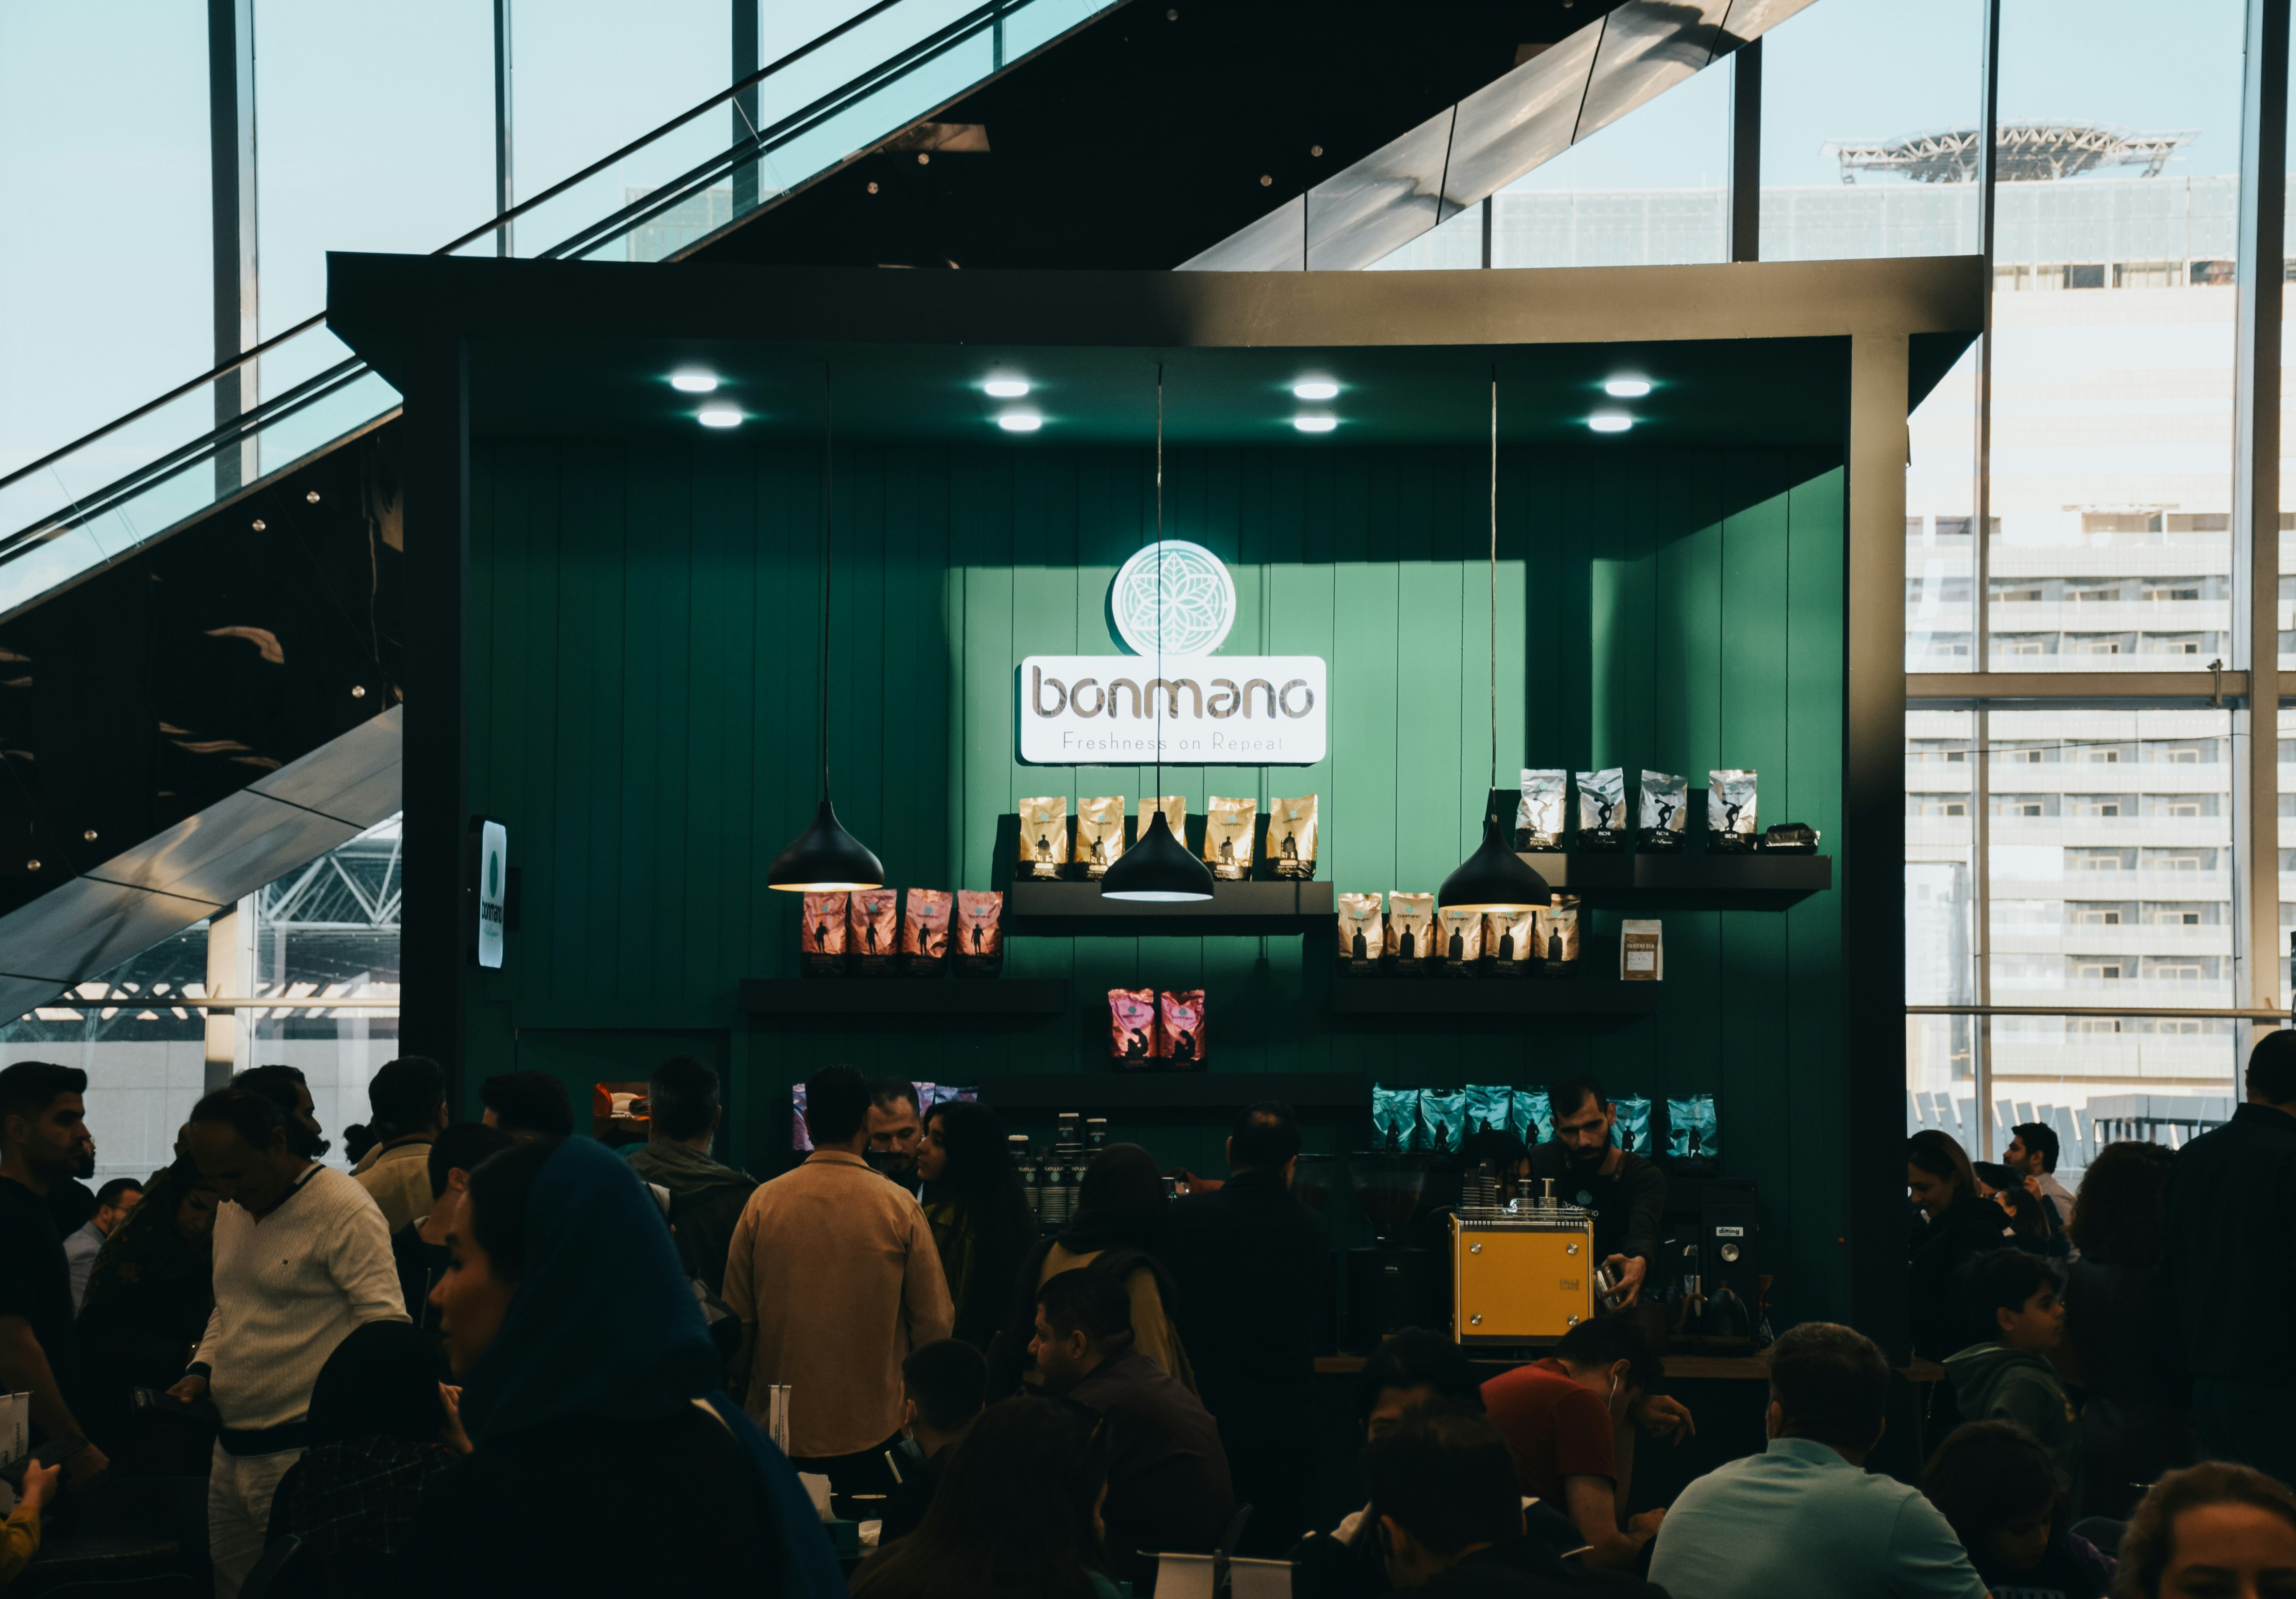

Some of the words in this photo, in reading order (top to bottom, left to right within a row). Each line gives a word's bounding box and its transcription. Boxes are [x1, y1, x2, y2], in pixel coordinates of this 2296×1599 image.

[1032, 665, 1315, 719] bonmano
[1063, 731, 1167, 750] Freshness
[1179, 739, 1201, 750] on
[1213, 732, 1283, 753] Repeat
[481, 895, 502, 924] bonmano
